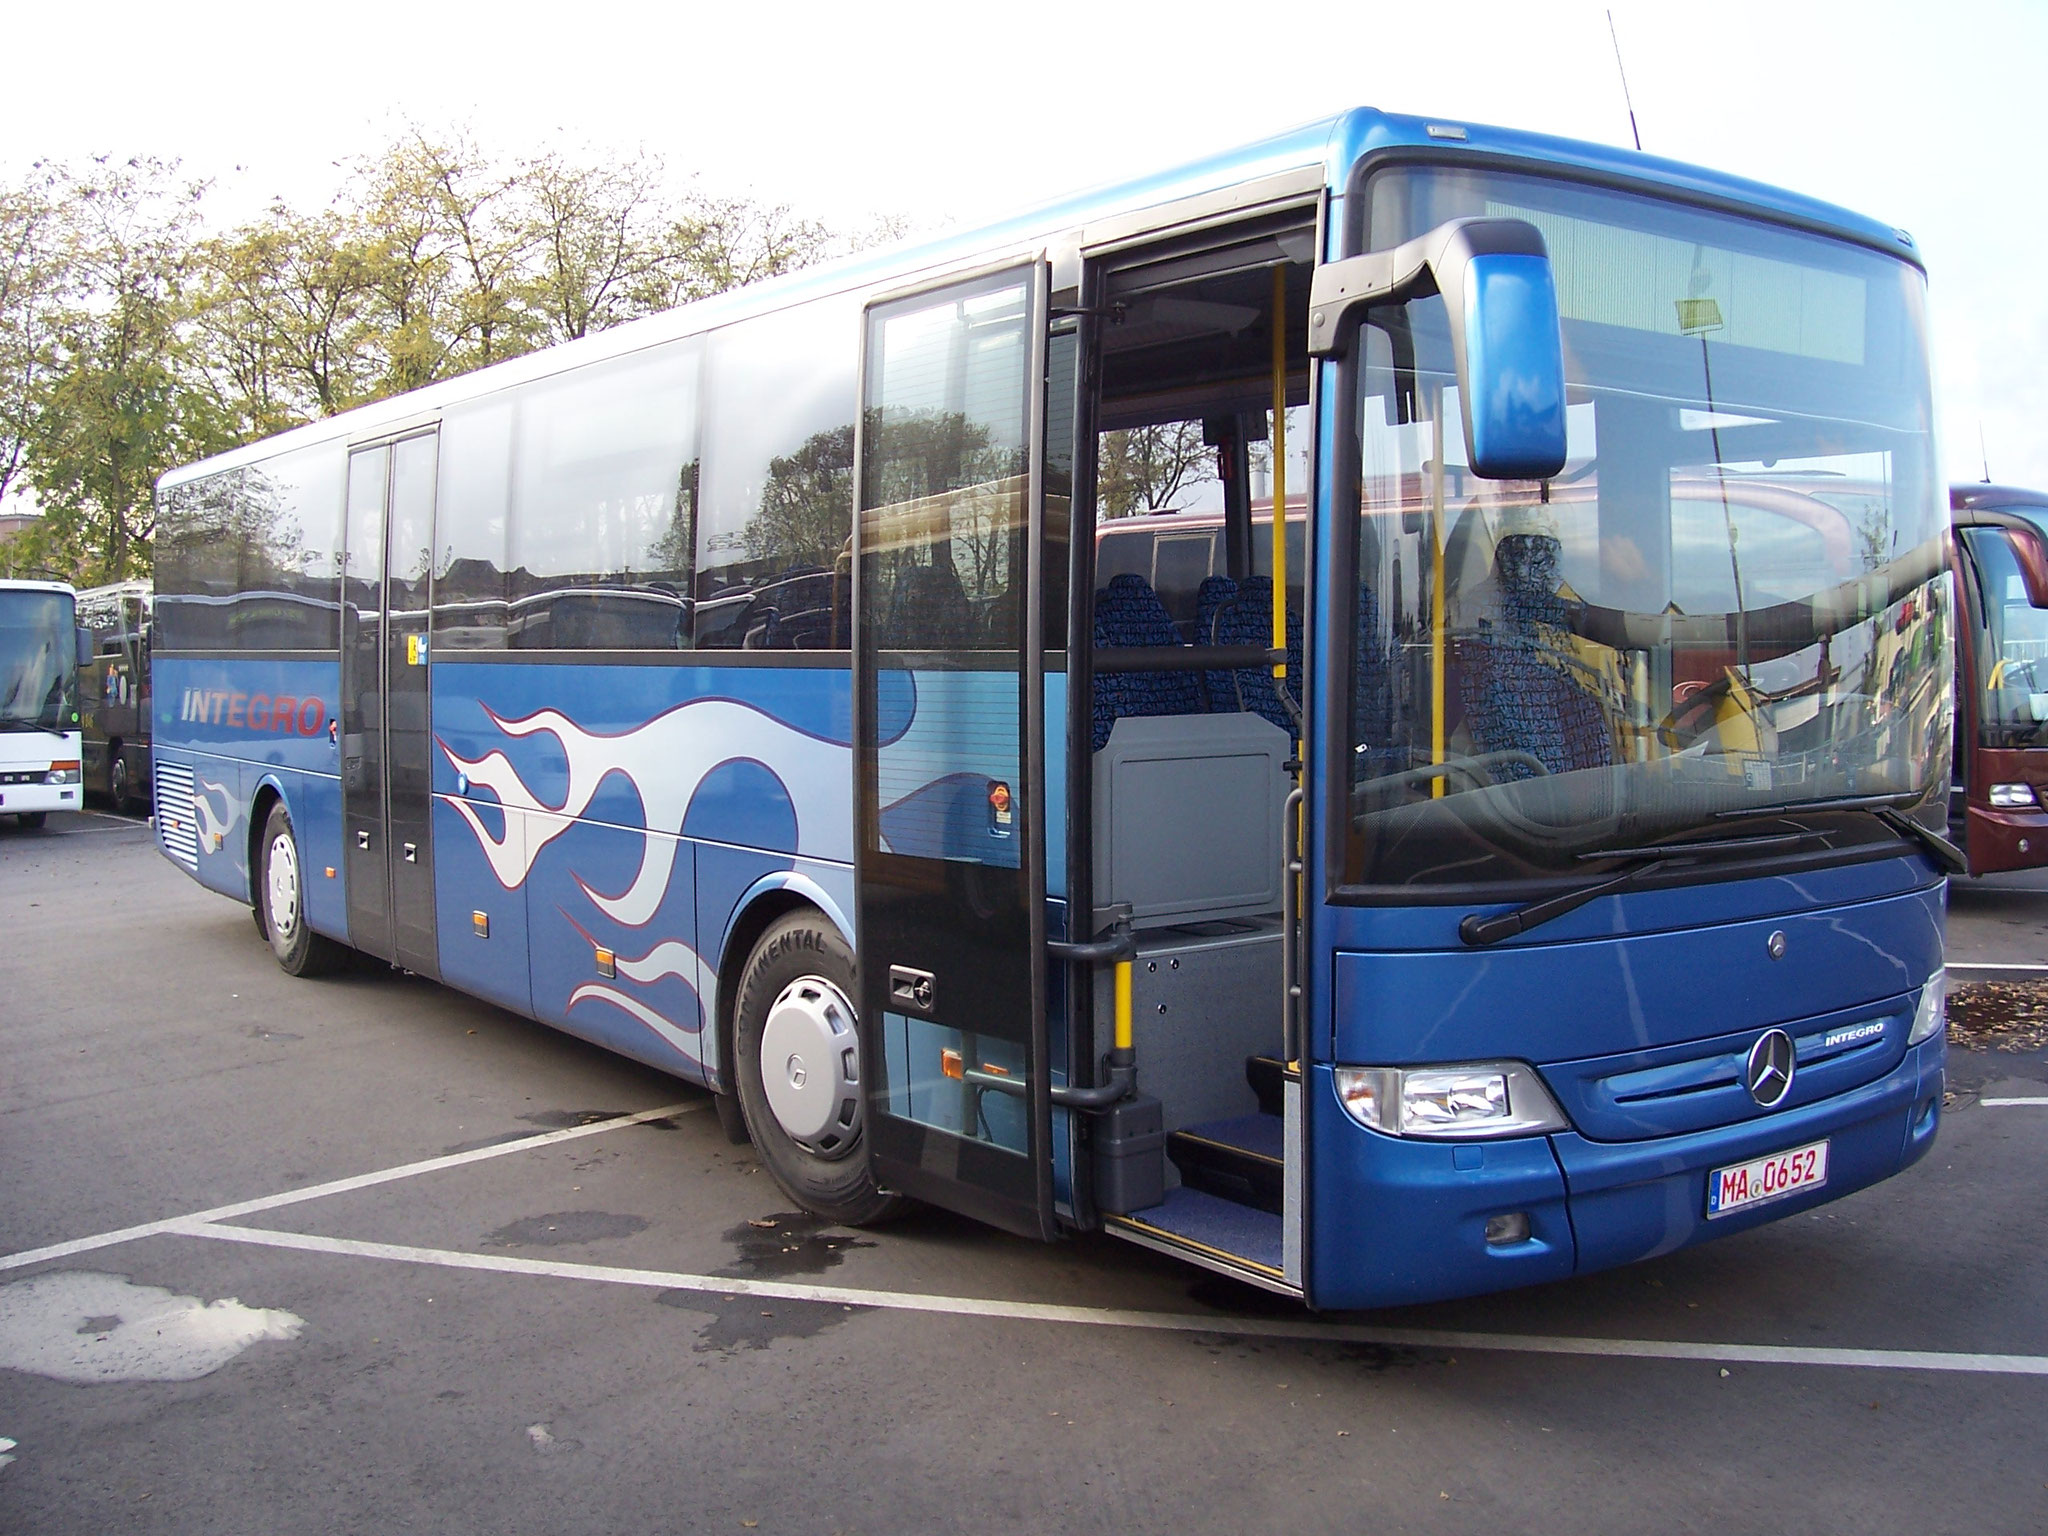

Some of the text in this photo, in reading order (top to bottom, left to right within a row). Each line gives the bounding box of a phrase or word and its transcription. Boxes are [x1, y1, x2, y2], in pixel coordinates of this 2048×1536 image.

[181, 688, 325, 736] INTEGRO
[1825, 1023, 1884, 1047] INTEGRO
[1721, 1169, 1748, 1205] MA
[1763, 1150, 1816, 1193] 0652
